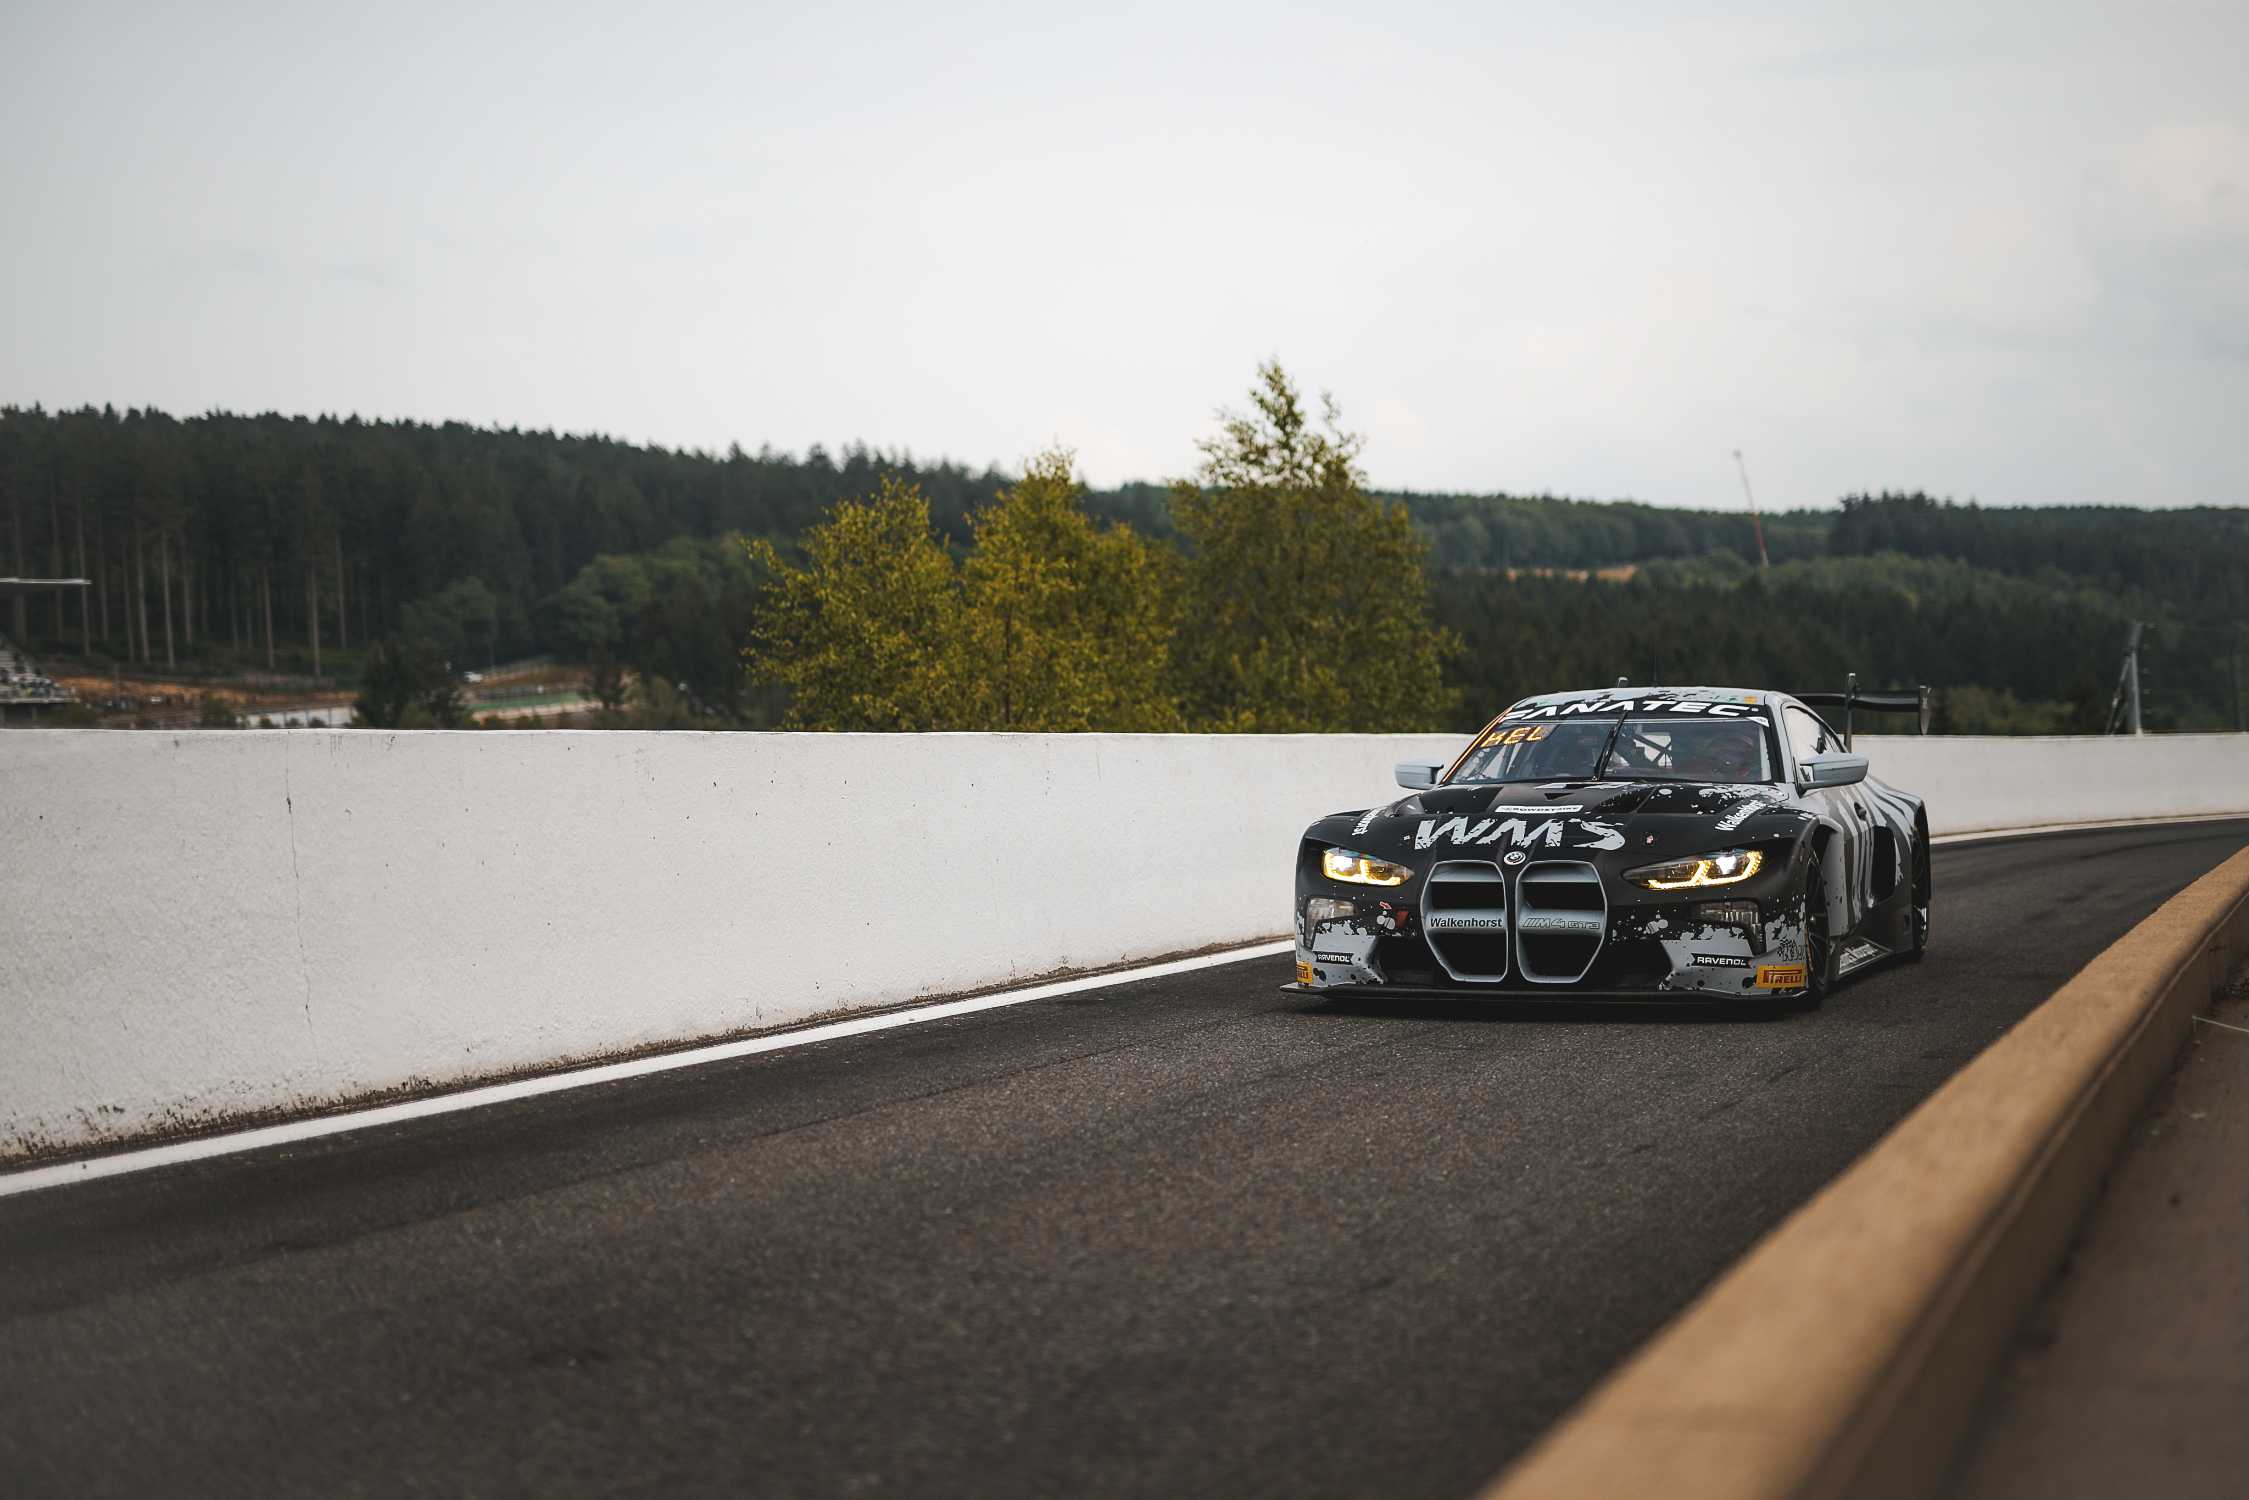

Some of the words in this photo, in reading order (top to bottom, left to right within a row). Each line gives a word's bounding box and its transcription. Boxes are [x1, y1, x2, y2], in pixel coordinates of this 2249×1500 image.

[1498, 700, 1750, 723] FANATEC
[1430, 917, 1503, 928] Walkenhorst
[1317, 954, 1351, 963] RAVENOL
[1697, 956, 1747, 966] RAVENOL
